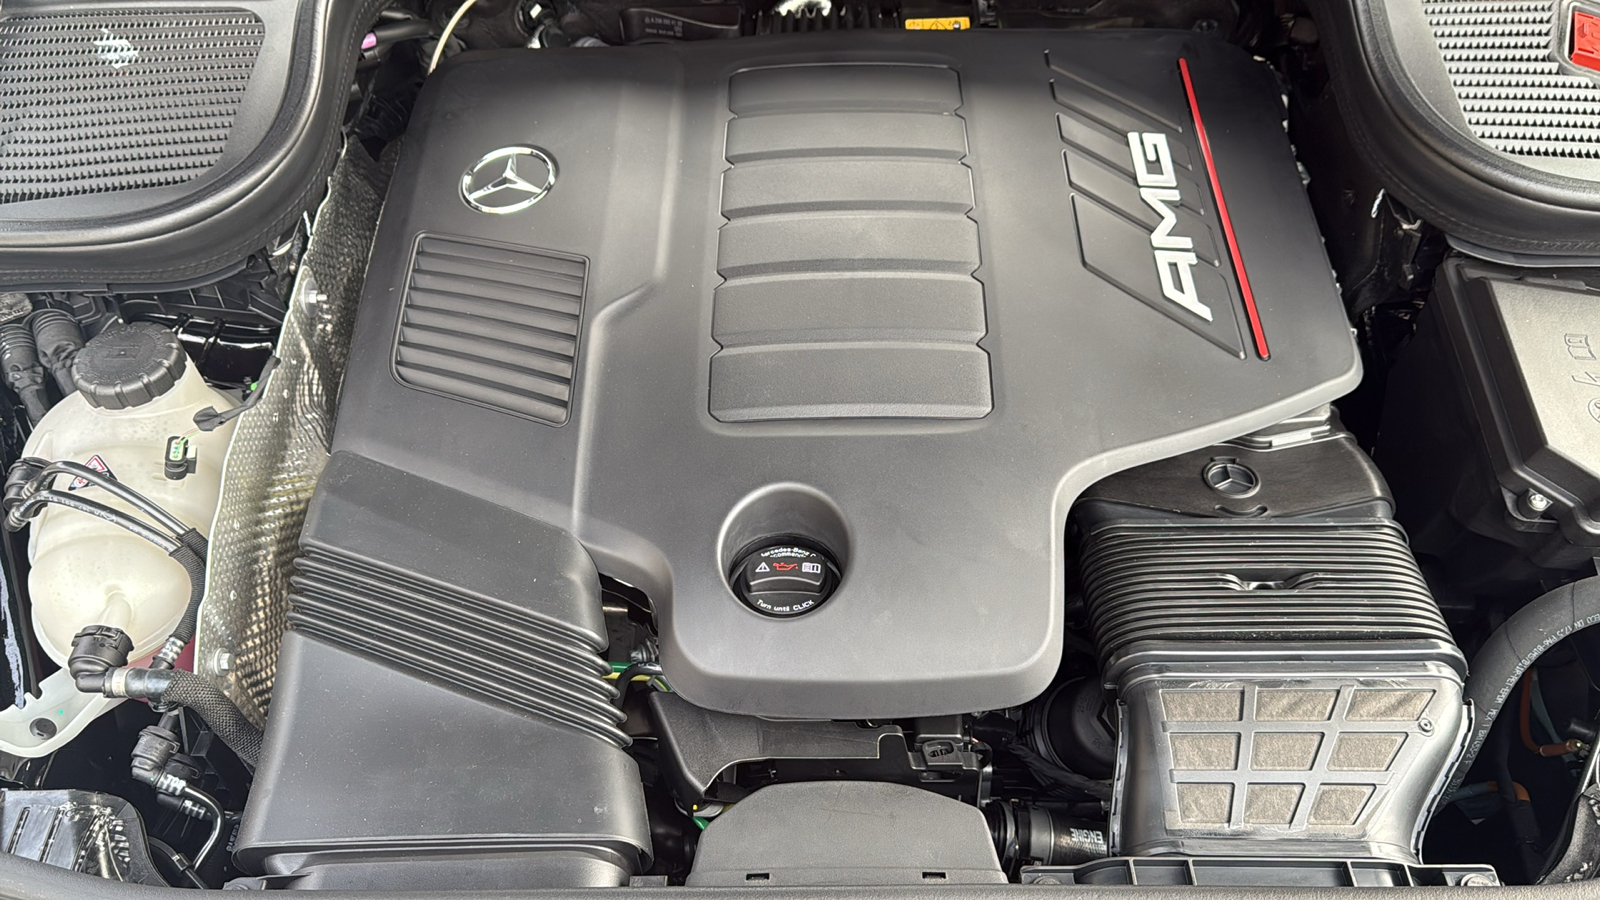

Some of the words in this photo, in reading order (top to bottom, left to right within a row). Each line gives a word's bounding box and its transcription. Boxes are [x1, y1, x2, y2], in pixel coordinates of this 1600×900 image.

[1127, 131, 1213, 322] AMG
[757, 599, 772, 610] Turn
[793, 600, 815, 611] CLICK
[1556, 625, 1572, 637] 17.5
[1070, 827, 1104, 843] ENGINE
